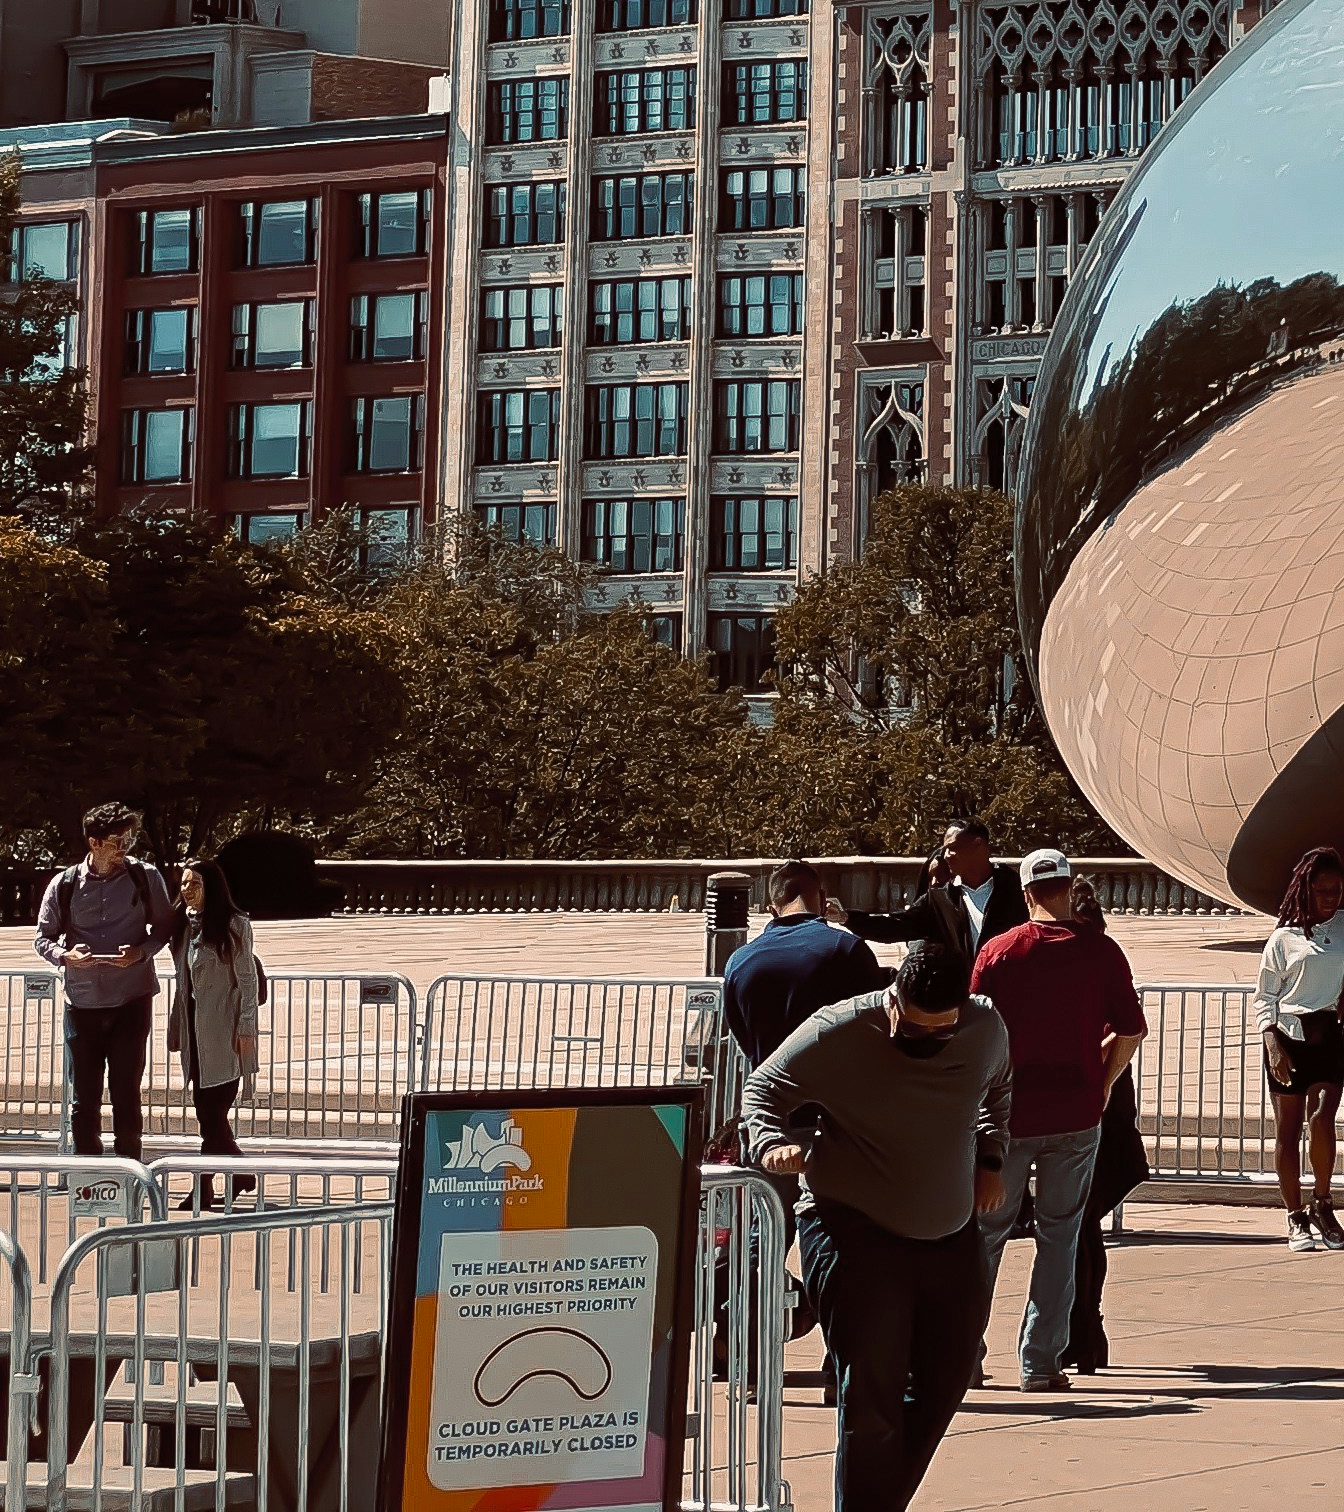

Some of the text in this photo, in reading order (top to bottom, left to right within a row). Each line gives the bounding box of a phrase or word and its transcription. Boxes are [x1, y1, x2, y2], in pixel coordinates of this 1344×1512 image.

[75, 1186, 117, 1201] SONCO
[443, 1196, 529, 1208] CHICAGO
[451, 1255, 648, 1277] THE HEALTH AND SAFETY
[449, 1276, 646, 1298] OF OUR VISITORS REMAIN
[458, 1297, 638, 1318] OUR HIGHEST PRIORITY
[438, 1411, 639, 1439] CLOUD GATE PLAZA IS
[434, 1433, 638, 1461] TEMPORARILY CLOSED
